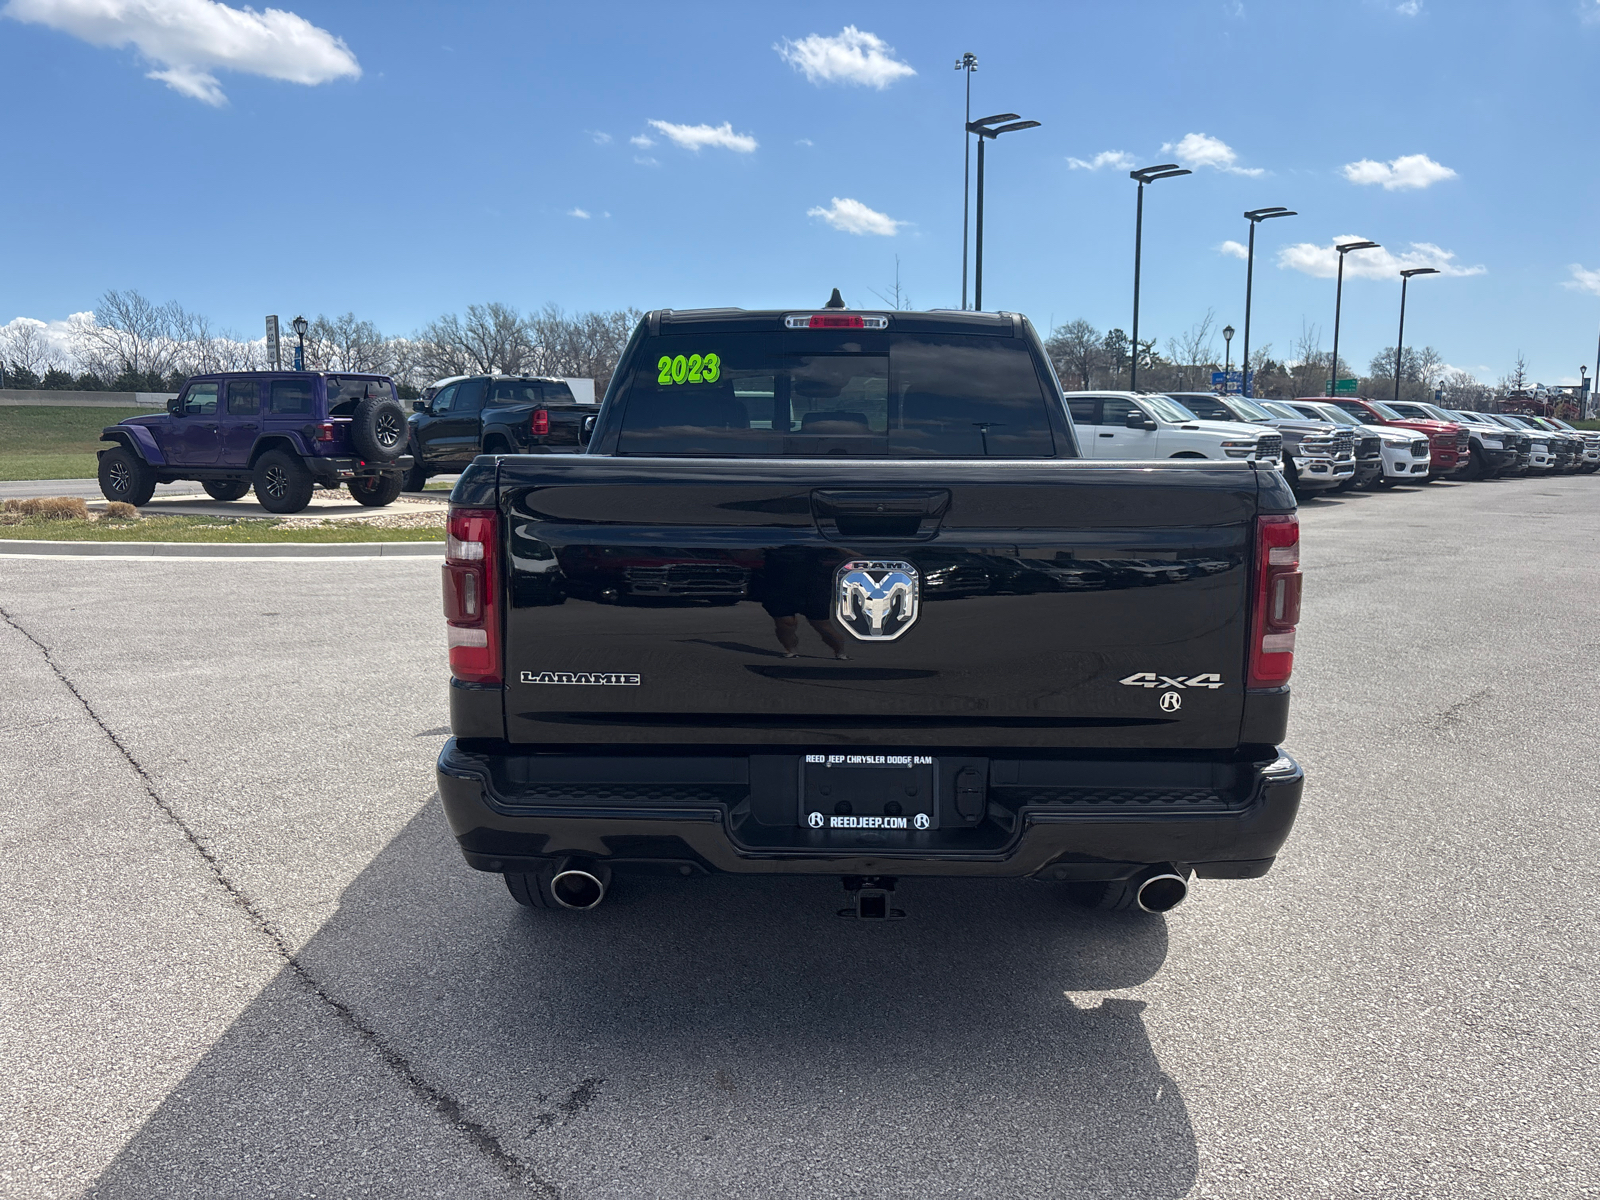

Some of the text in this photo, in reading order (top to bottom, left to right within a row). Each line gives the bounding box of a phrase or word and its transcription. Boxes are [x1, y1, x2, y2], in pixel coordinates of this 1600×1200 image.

[658, 353, 721, 386] 2023
[521, 671, 640, 686] LARAMIE
[806, 755, 932, 764] REED JEEP CHRYSLER DODGE RAM
[830, 816, 907, 828] REEDJEEP.COM
